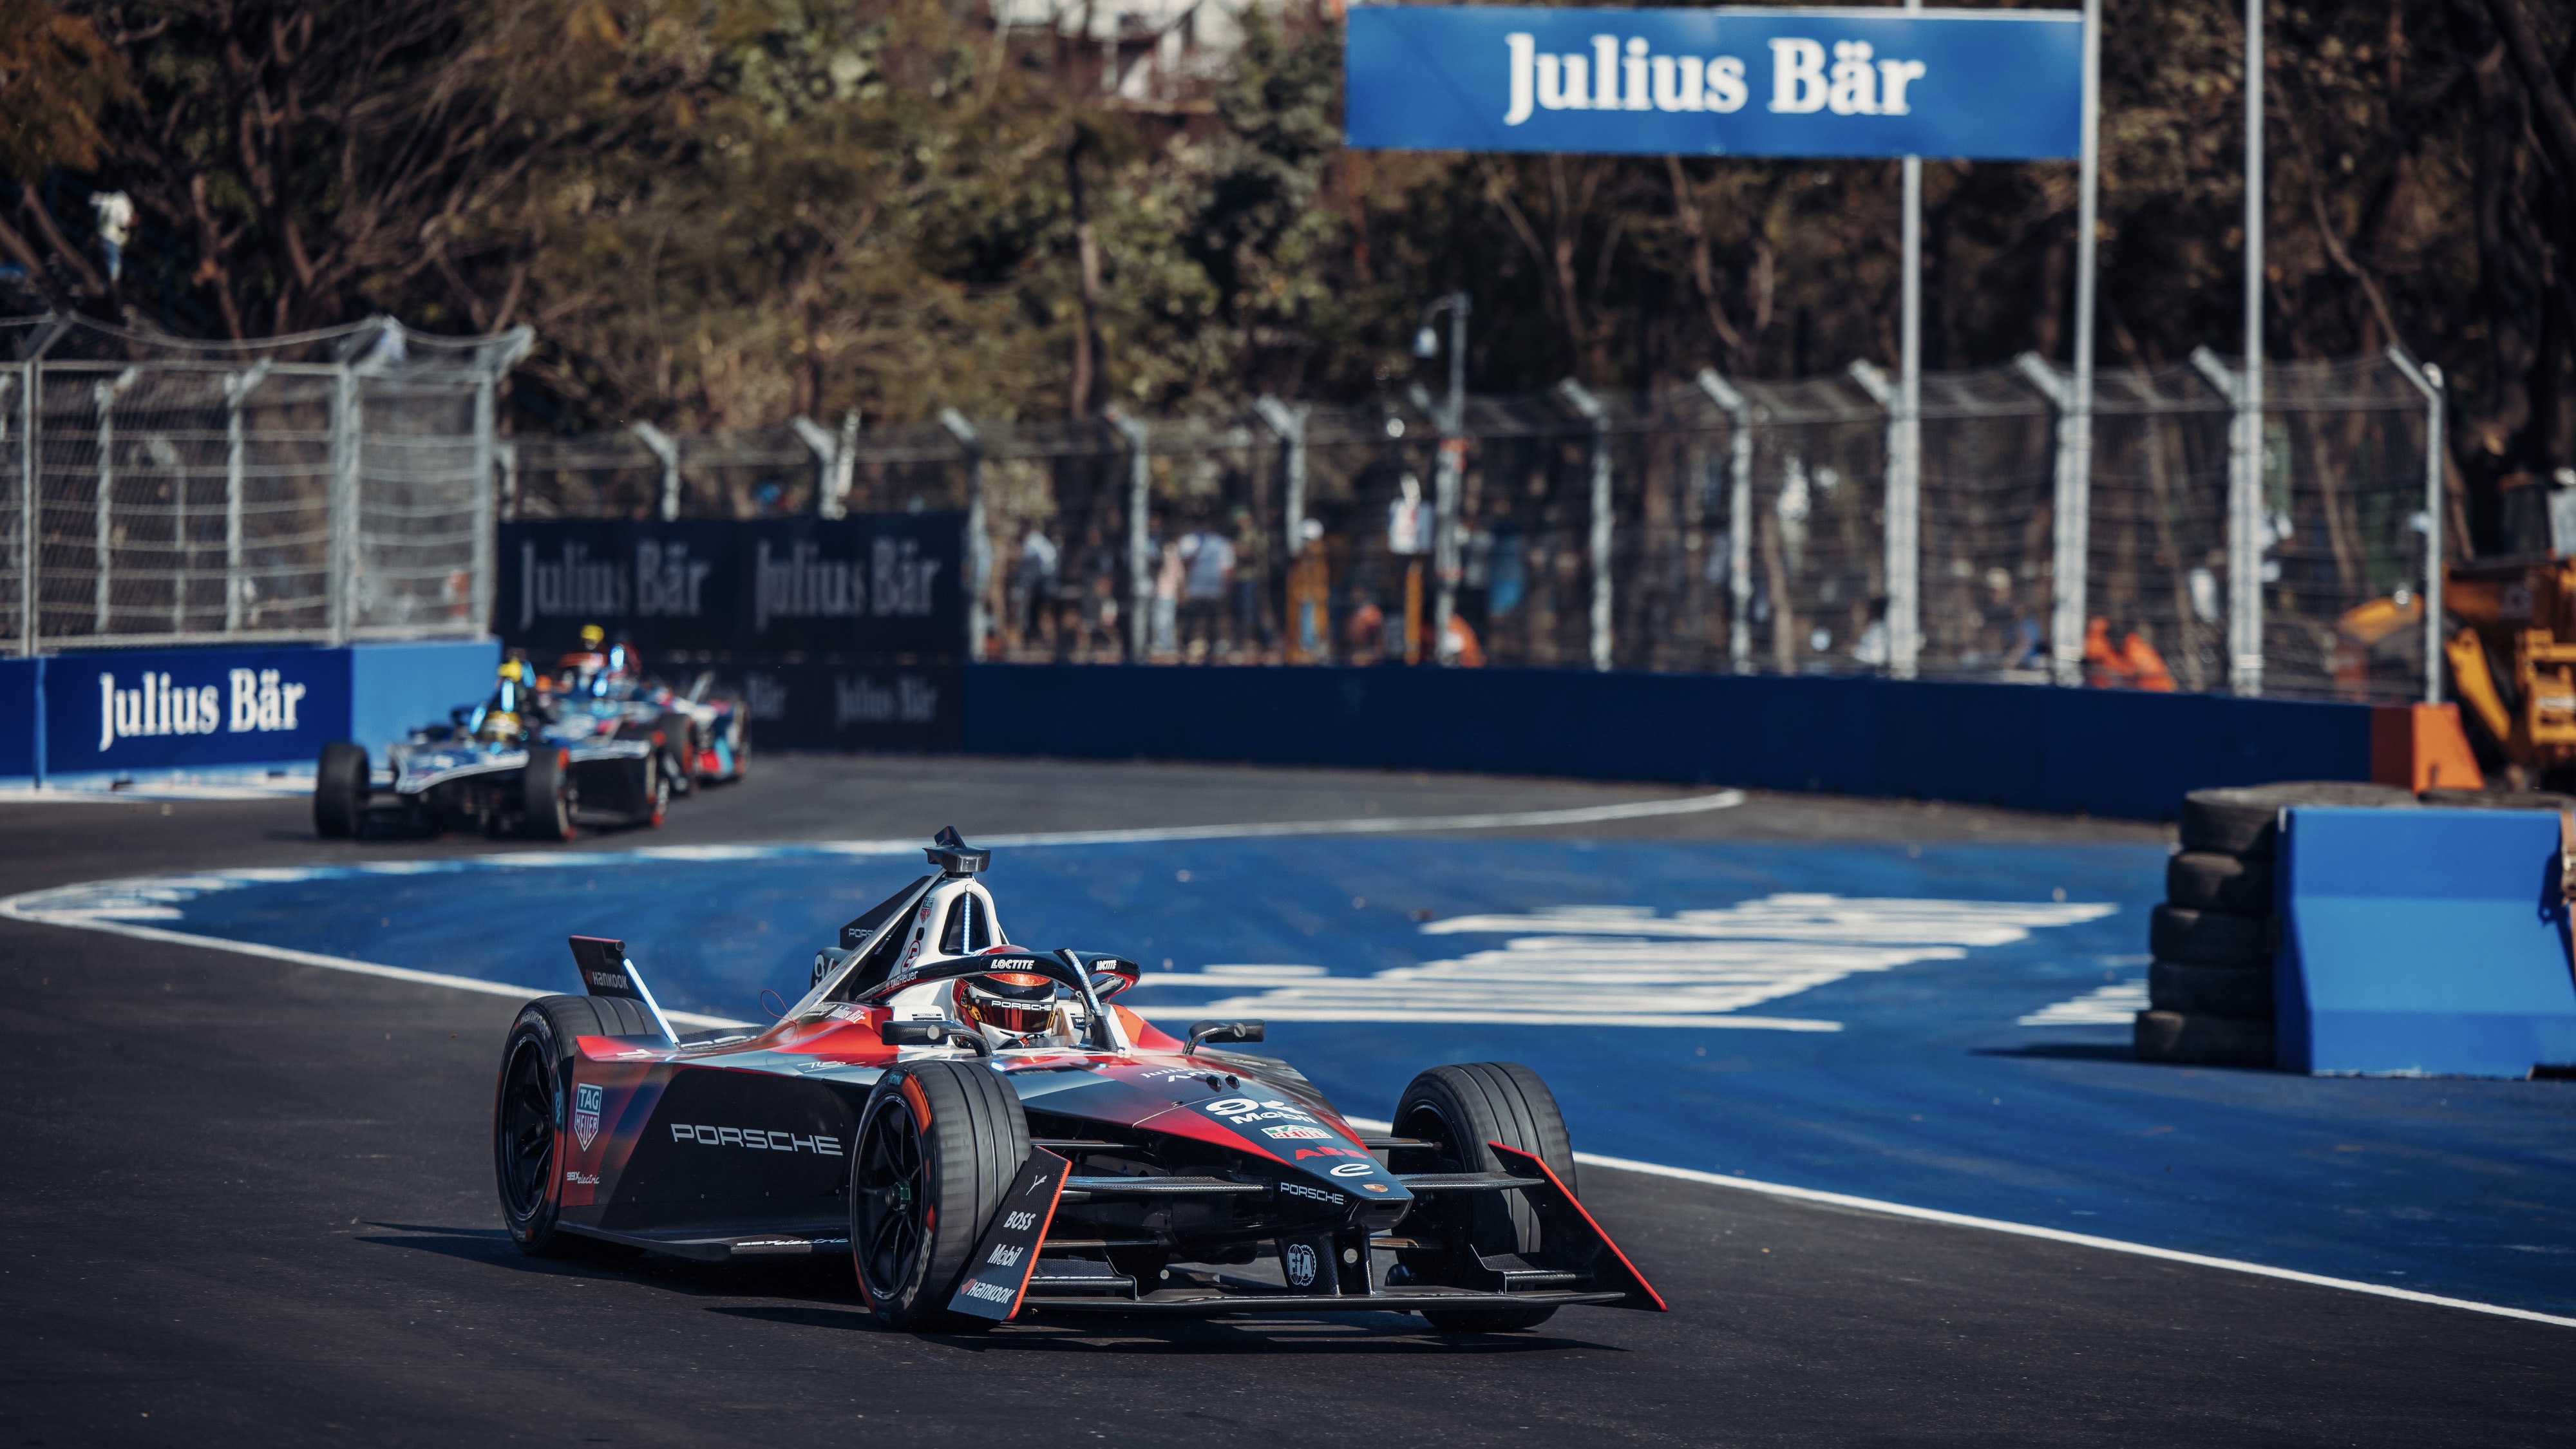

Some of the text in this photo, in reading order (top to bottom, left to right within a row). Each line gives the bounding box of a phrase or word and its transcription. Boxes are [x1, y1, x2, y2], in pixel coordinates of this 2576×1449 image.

[1504, 32, 1927, 126] Julius Bär
[519, 538, 711, 631] Julius Bär
[755, 537, 942, 633] Julius Bär
[99, 668, 307, 752] Julius Bär
[990, 959, 1035, 970] LOCTITE
[991, 1000, 1052, 1011] PORSCHE
[580, 1088, 600, 1110] TAG
[1206, 1098, 1309, 1115] 94
[576, 1114, 598, 1144] HEUER
[1229, 1112, 1318, 1124] Mobil
[670, 1123, 844, 1156] PORSCHE
[1295, 1146, 1368, 1160] ABB
[1280, 1182, 1344, 1205] PORSCHE
[1003, 1211, 1036, 1231] BOSS
[987, 1244, 1023, 1267] Mobil
